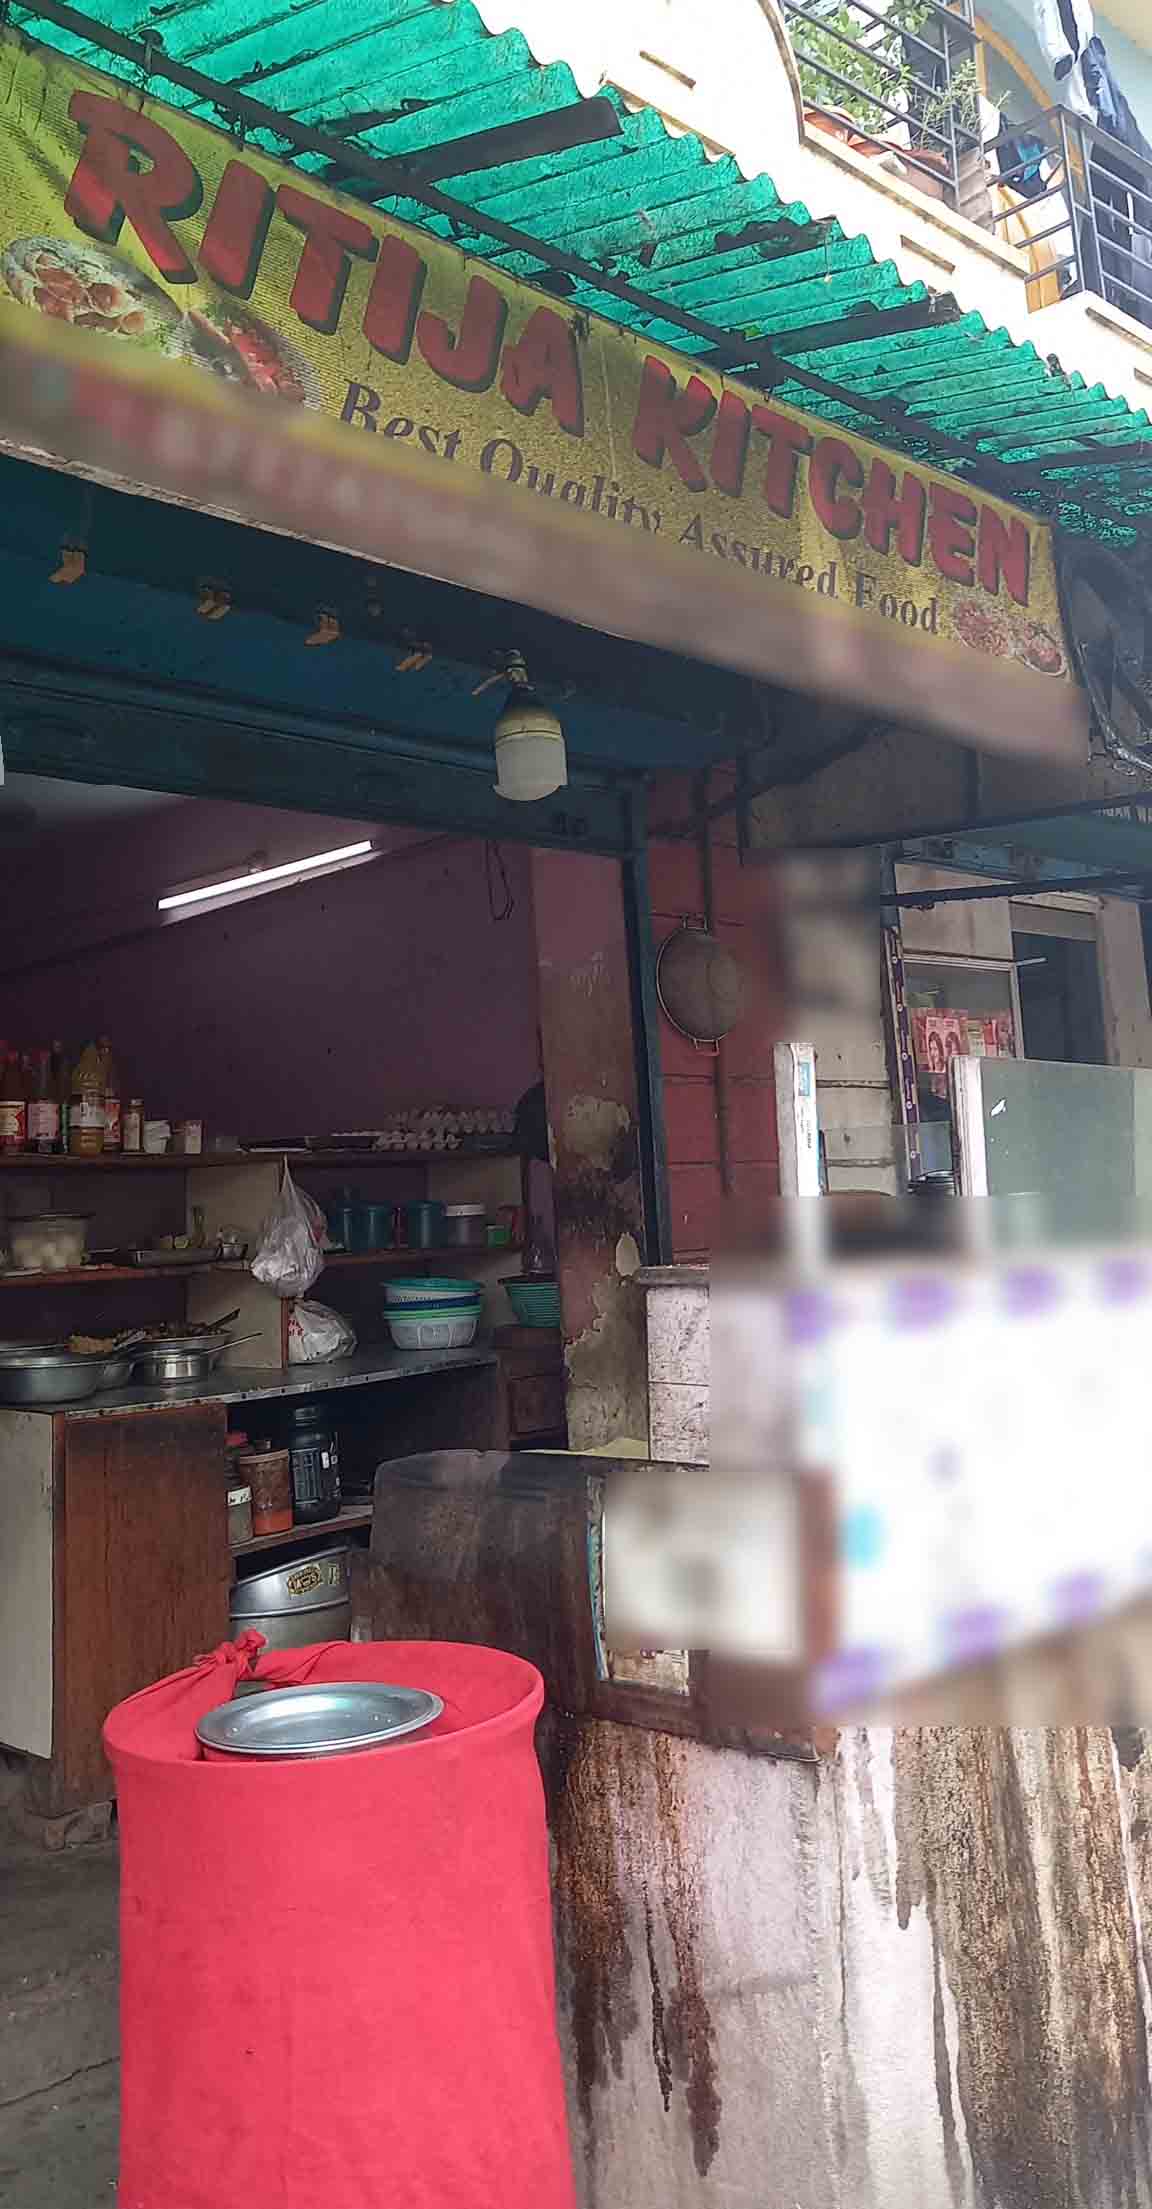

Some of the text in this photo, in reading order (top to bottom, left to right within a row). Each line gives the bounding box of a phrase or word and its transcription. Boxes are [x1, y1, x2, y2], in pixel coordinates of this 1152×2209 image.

[64, 89, 586, 438] RITIJA
[631, 355, 1031, 608] KITCHEN
[340, 378, 462, 459] Best
[855, 570, 938, 635] Food
